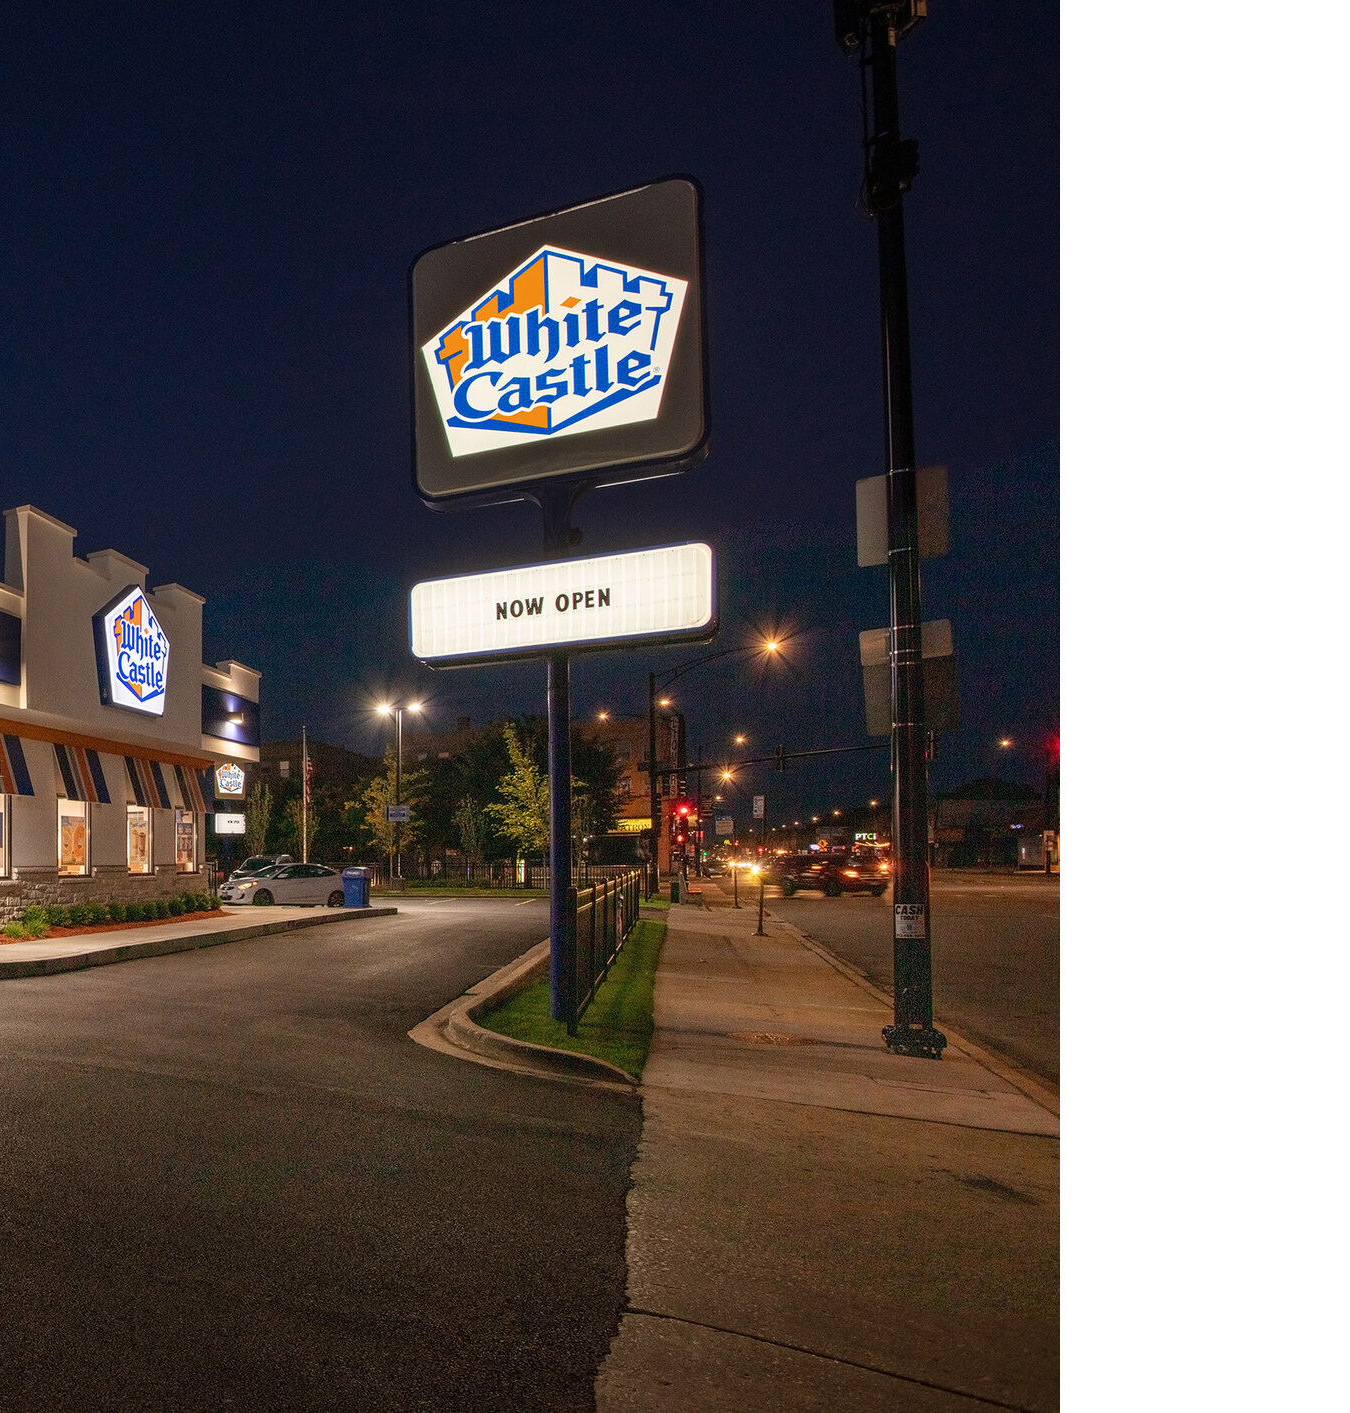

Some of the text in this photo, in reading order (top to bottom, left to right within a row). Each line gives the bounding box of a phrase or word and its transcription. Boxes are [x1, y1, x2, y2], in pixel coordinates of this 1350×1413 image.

[463, 296, 642, 373] White
[453, 343, 651, 419] Castle
[496, 588, 610, 620] NOW OPEN
[121, 620, 161, 661] White
[118, 651, 163, 690] Castle
[220, 779, 241, 787] Castle
[221, 769, 240, 780] White
[895, 905, 923, 915] CASH
